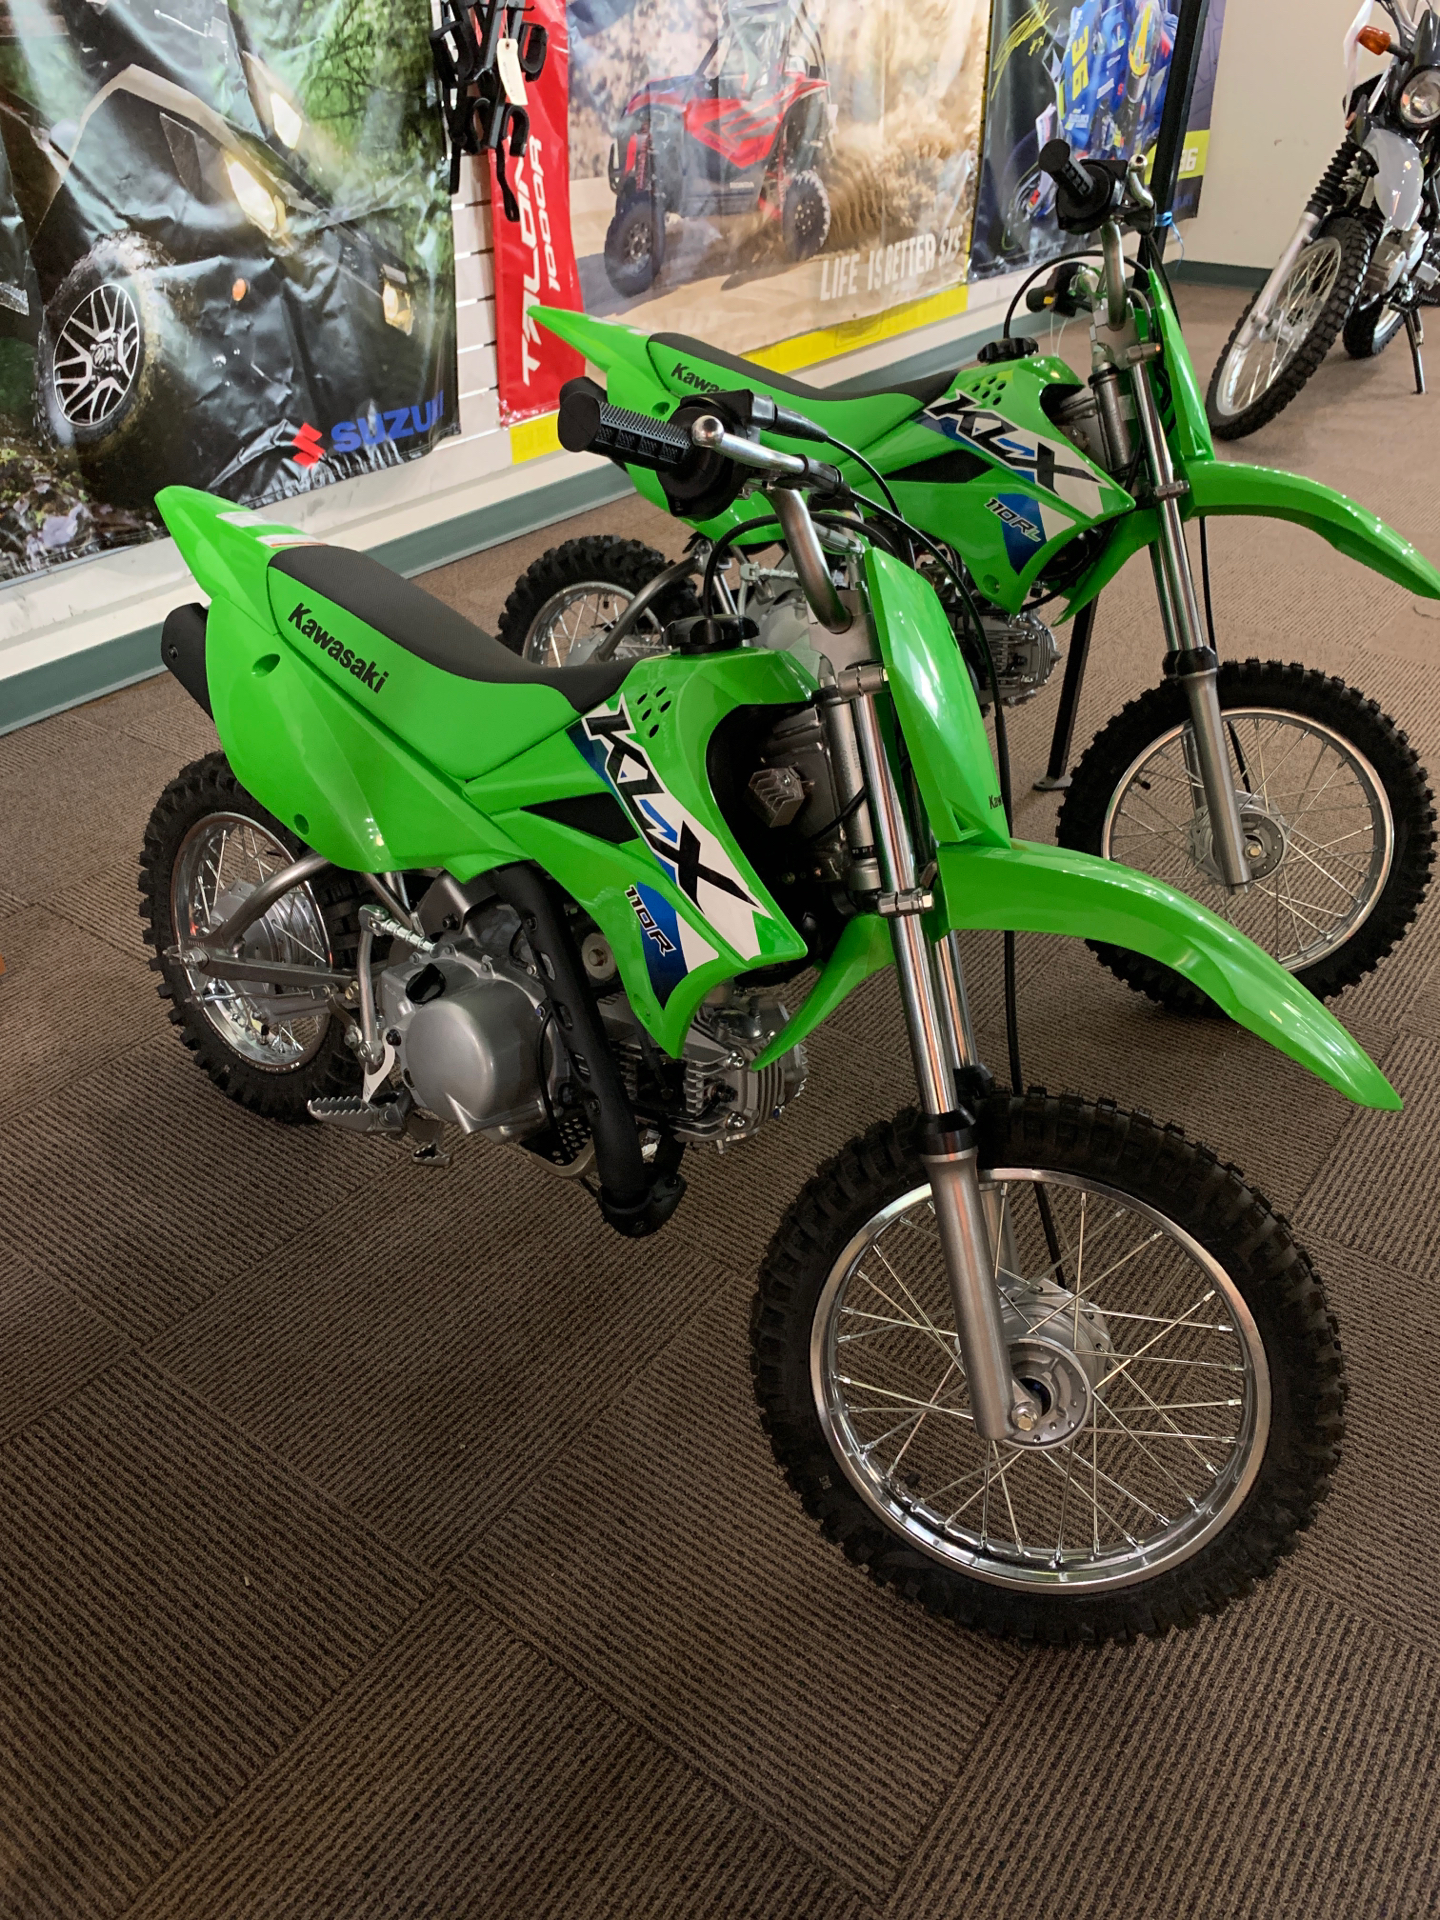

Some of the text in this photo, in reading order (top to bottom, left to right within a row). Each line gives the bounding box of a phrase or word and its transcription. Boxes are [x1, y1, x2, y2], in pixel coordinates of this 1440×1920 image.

[529, 135, 560, 292] 1000R
[820, 253, 861, 301] LIFE
[867, 249, 884, 291] IS
[884, 233, 937, 286] BETTER
[671, 362, 728, 393] Kawa
[924, 390, 1106, 497] KLX
[984, 497, 1042, 543] 110RL
[287, 602, 390, 694] Kawasaki
[583, 698, 764, 916] KLX
[624, 885, 677, 957] 110R
